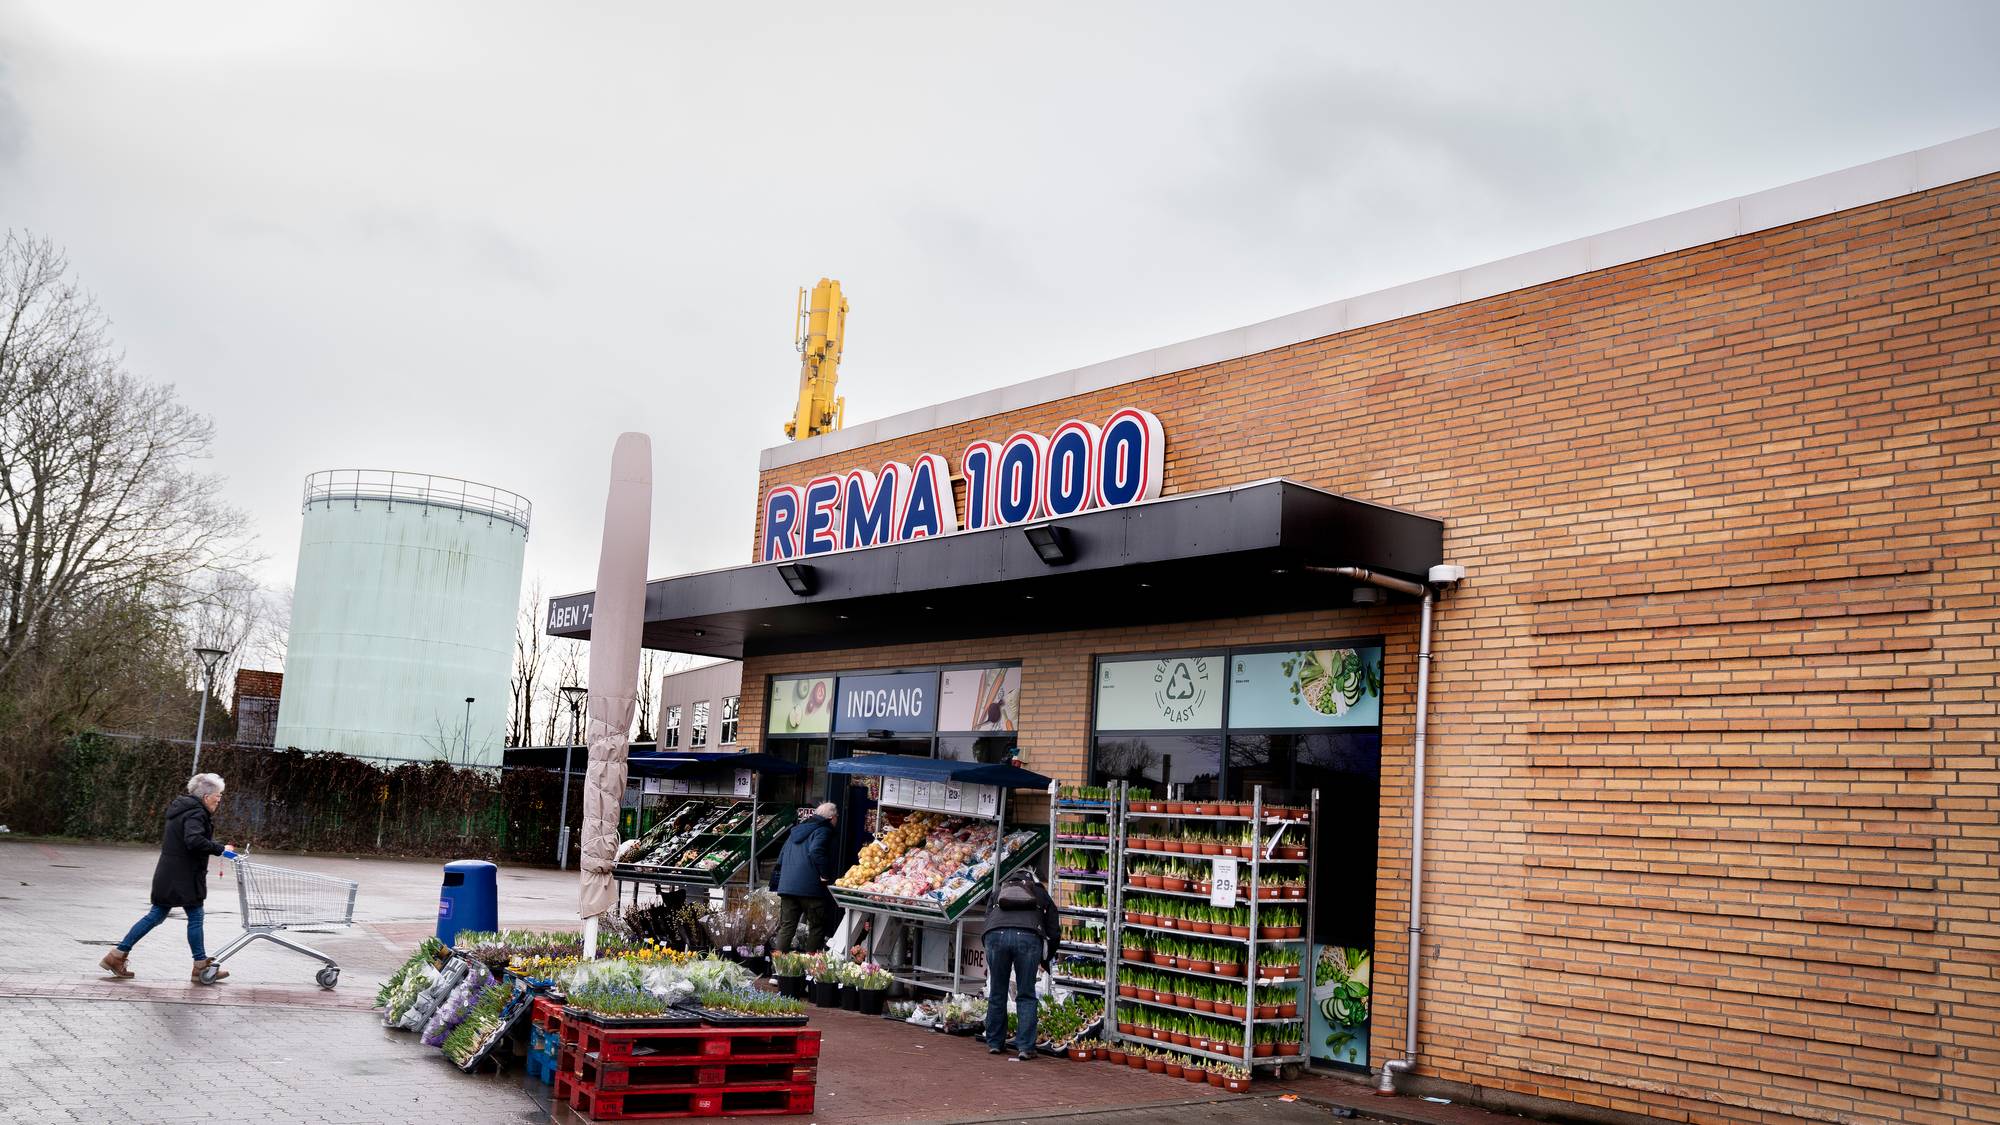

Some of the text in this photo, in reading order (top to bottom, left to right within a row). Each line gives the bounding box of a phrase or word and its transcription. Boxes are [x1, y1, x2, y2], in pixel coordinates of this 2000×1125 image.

[762, 409, 1152, 561] REMA 1000
[549, 601, 579, 629] ÅBEN
[847, 687, 923, 718] INDGANG
[1163, 705, 1195, 723] PLAST
